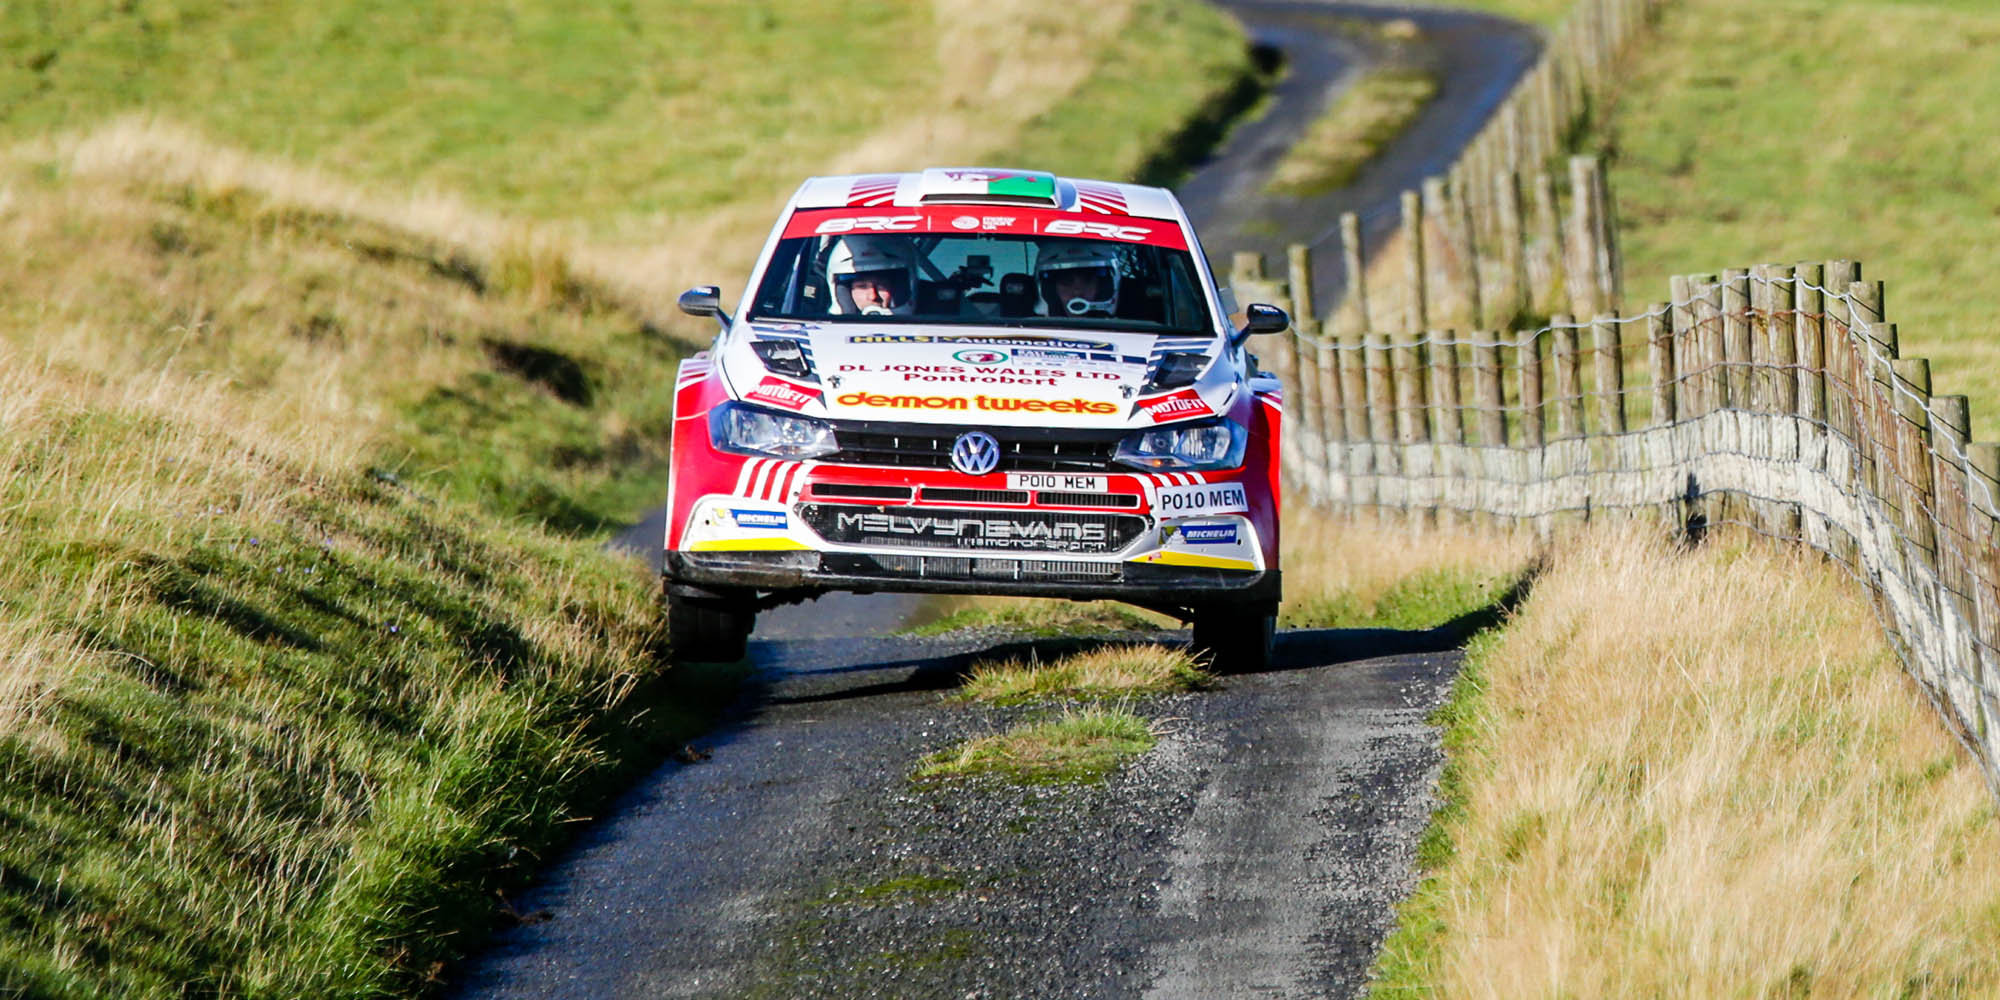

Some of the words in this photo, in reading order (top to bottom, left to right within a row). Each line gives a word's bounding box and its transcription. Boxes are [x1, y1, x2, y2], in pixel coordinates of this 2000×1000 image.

[815, 215, 924, 234] BRC
[1044, 219, 1152, 241] BRC
[956, 337, 1091, 349] Automotive
[880, 365, 966, 373] JONES
[975, 367, 1066, 378] WALES
[1075, 371, 1121, 381] LTD
[904, 373, 1057, 386] Pontrobert
[838, 392, 966, 410] demon
[974, 395, 1117, 415] tweeks
[1144, 399, 1206, 416] MOTOFIT
[1020, 474, 1056, 487] PO10
[1064, 475, 1096, 489] MEM
[1161, 491, 1205, 511] PO10
[1209, 489, 1246, 507] MEM
[1186, 529, 1237, 538] MICHELIN
